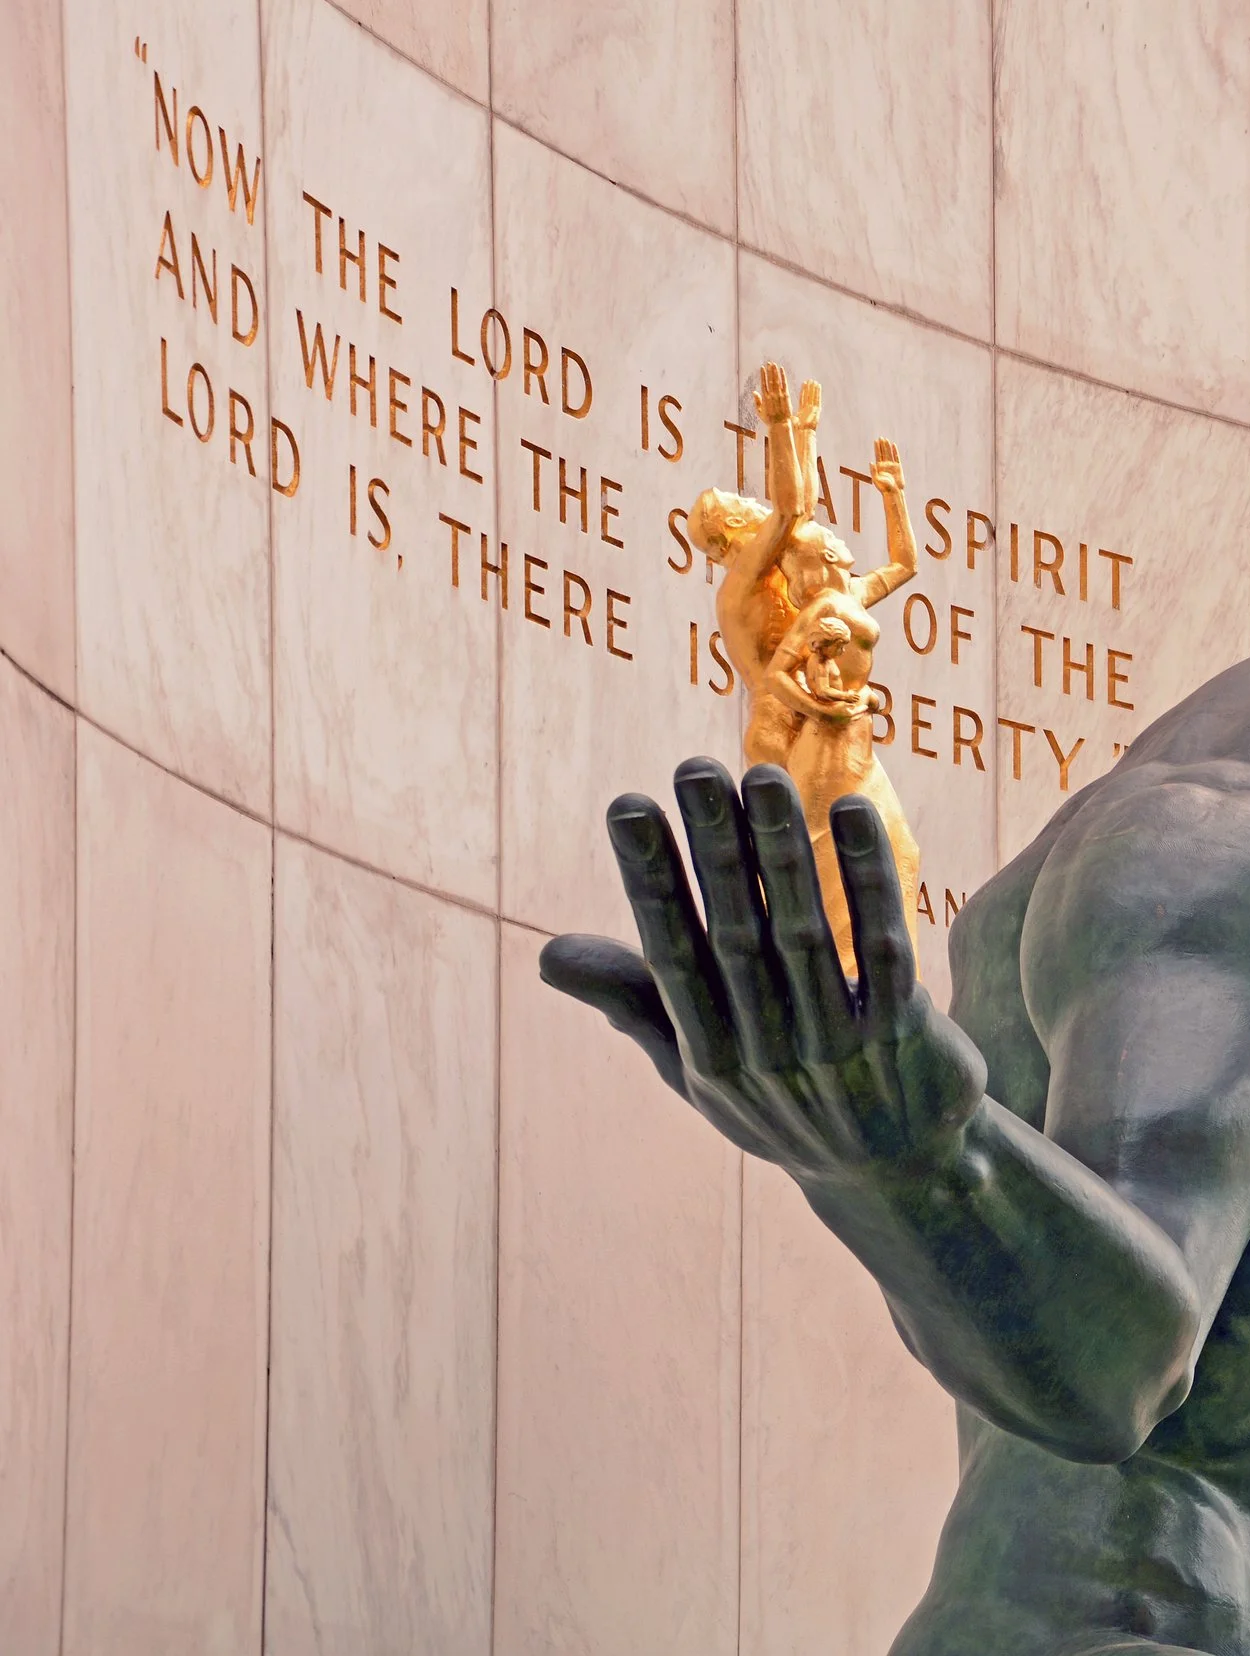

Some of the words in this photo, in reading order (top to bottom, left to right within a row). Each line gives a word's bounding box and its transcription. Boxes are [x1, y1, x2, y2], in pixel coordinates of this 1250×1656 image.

[154, 210, 259, 347] AND
[295, 308, 483, 485] WHERE
[520, 438, 624, 549] THE
[903, 592, 975, 665] OF
[1021, 625, 1135, 711] THE
[160, 337, 300, 498] LORD
[349, 464, 403, 572] IS,
[439, 512, 633, 661] THERE
[689, 621, 735, 696] IS
[302, 190, 402, 325] THE
[450, 286, 593, 420] LORD
[640, 384, 684, 463] IS
[723, 420, 873, 533] TAT
[925, 498, 1133, 610] SPIRIT
